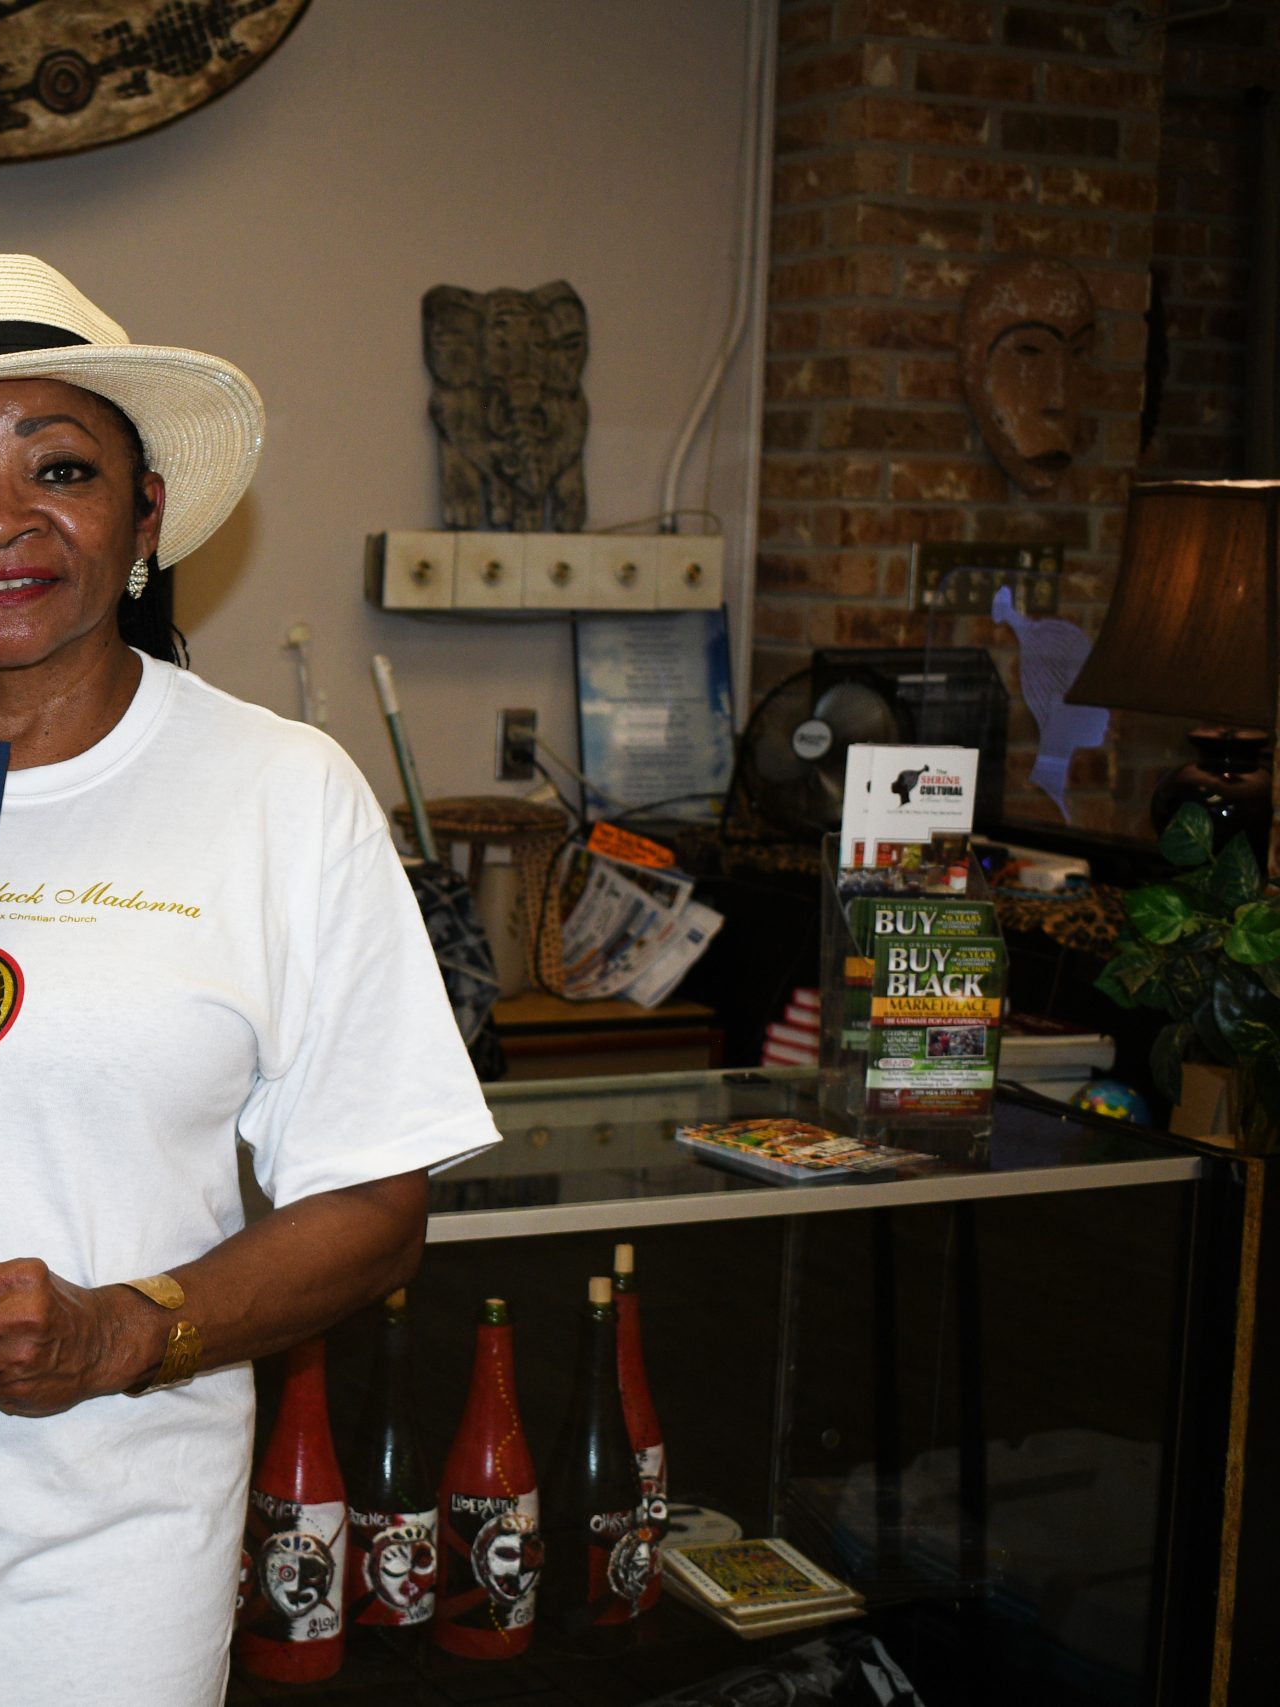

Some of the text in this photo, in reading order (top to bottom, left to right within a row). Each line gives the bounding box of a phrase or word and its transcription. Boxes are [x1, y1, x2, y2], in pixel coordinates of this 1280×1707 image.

[921, 776, 960, 785] SHRINE
[920, 786, 963, 796] CULTURAL
[53, 881, 201, 918] Madonna
[9, 913, 55, 922] Christian
[59, 915, 97, 923] Church
[875, 910, 938, 936] BUY
[888, 948, 952, 973] BUY
[887, 973, 985, 997] BLACK
[890, 999, 990, 1011] MARKETPLACE
